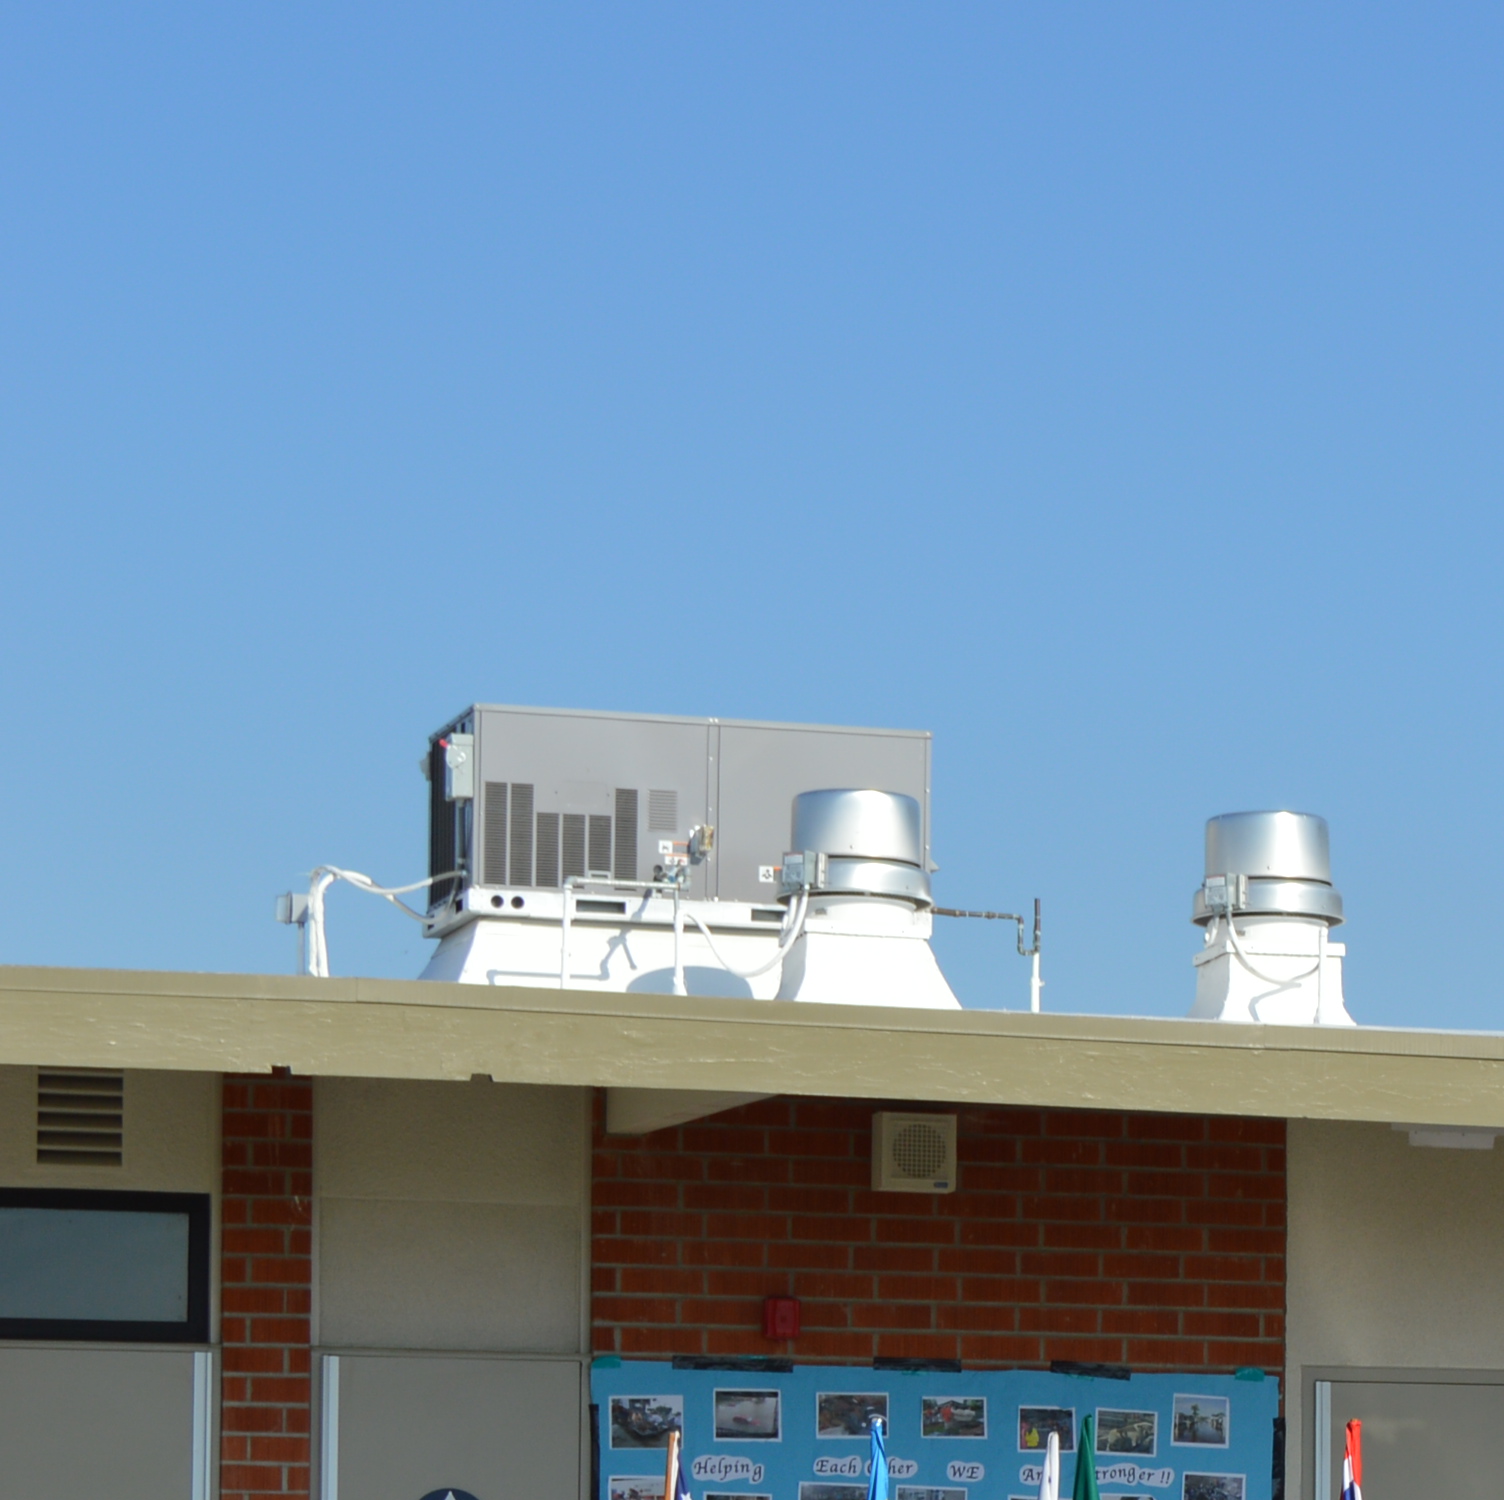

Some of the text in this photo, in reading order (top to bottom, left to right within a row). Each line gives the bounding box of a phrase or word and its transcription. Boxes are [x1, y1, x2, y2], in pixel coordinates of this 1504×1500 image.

[693, 1457, 763, 1482] Helping
[815, 1458, 858, 1475] Each
[867, 1458, 914, 1475] her
[949, 1465, 980, 1480] WE
[1022, 1468, 1042, 1482] Ar
[1095, 1464, 1154, 1484] tronger
